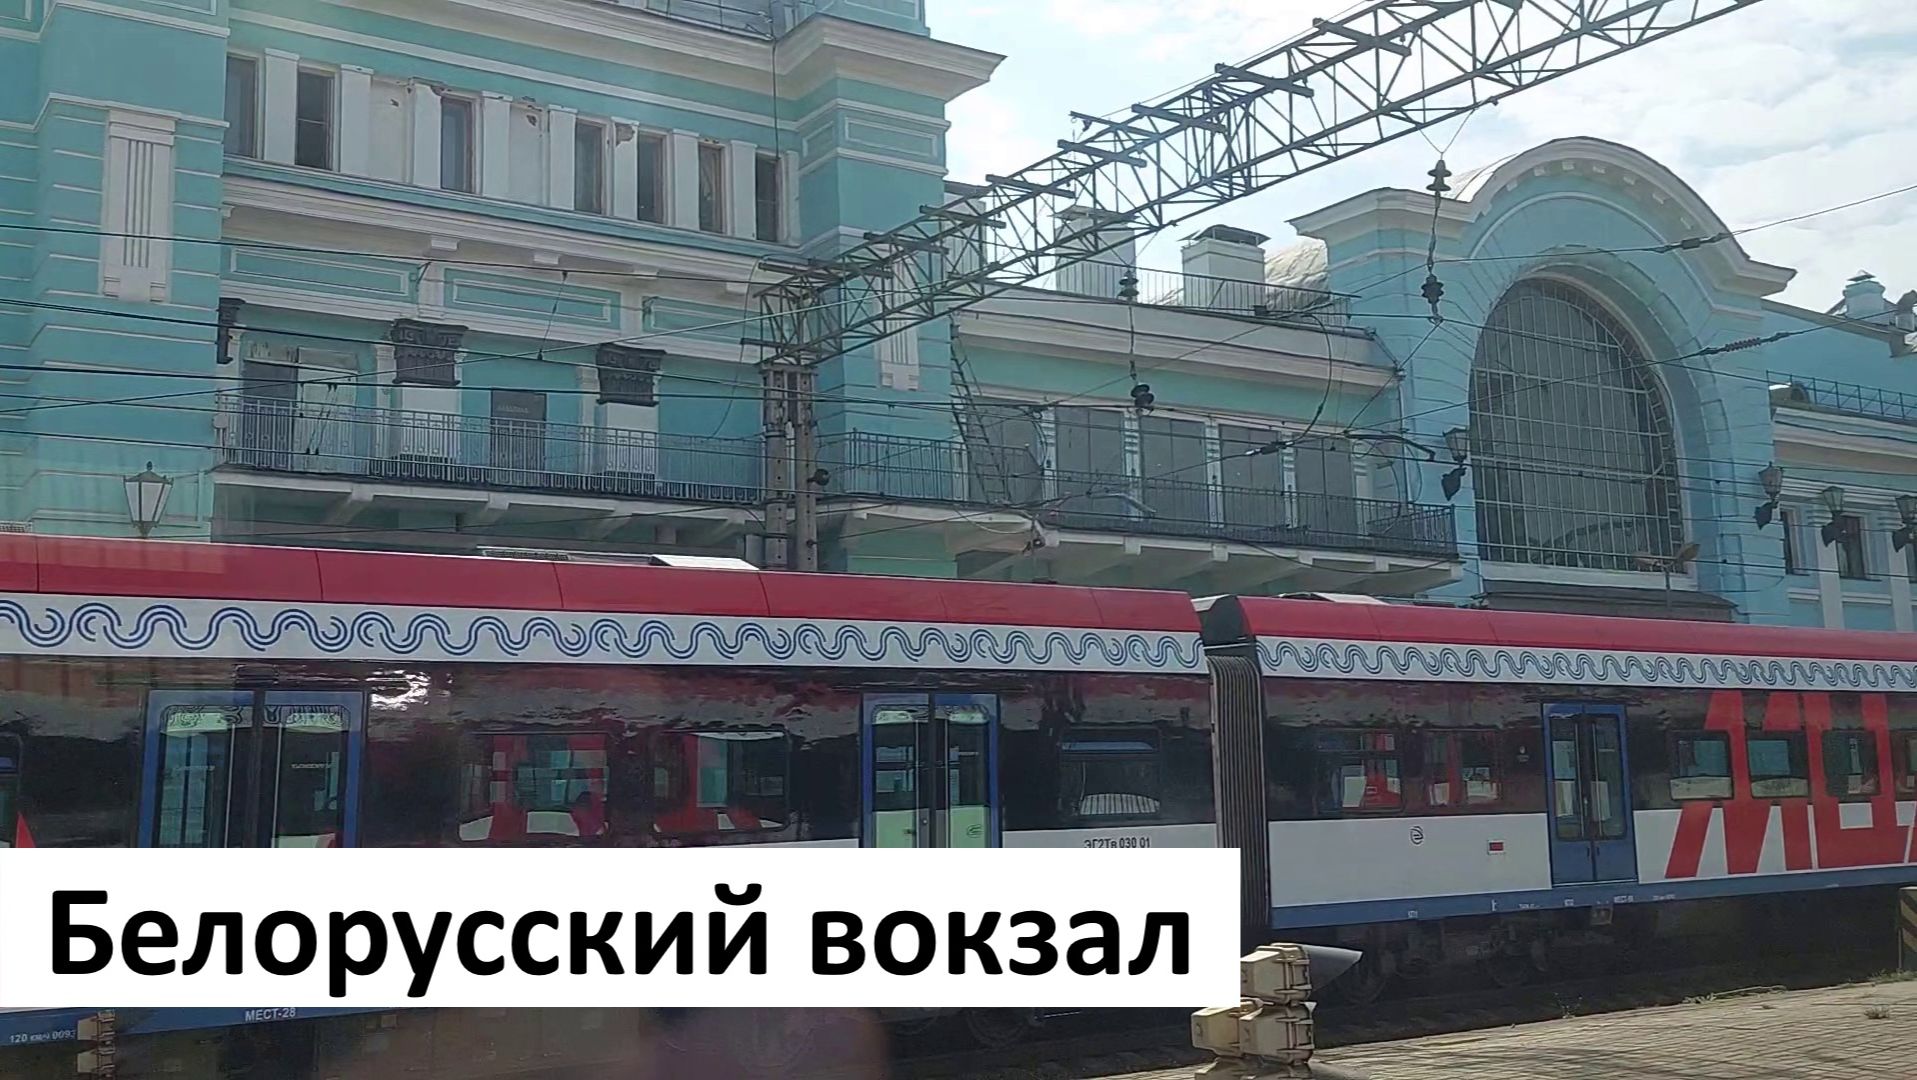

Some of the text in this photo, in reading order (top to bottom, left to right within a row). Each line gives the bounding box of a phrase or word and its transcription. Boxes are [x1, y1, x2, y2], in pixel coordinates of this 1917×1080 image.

[1119, 837, 1136, 848] 030
[1140, 837, 1150, 848] 01
[245, 1007, 296, 1022] МЕСТ-28
[9, 1034, 28, 1043] 120
